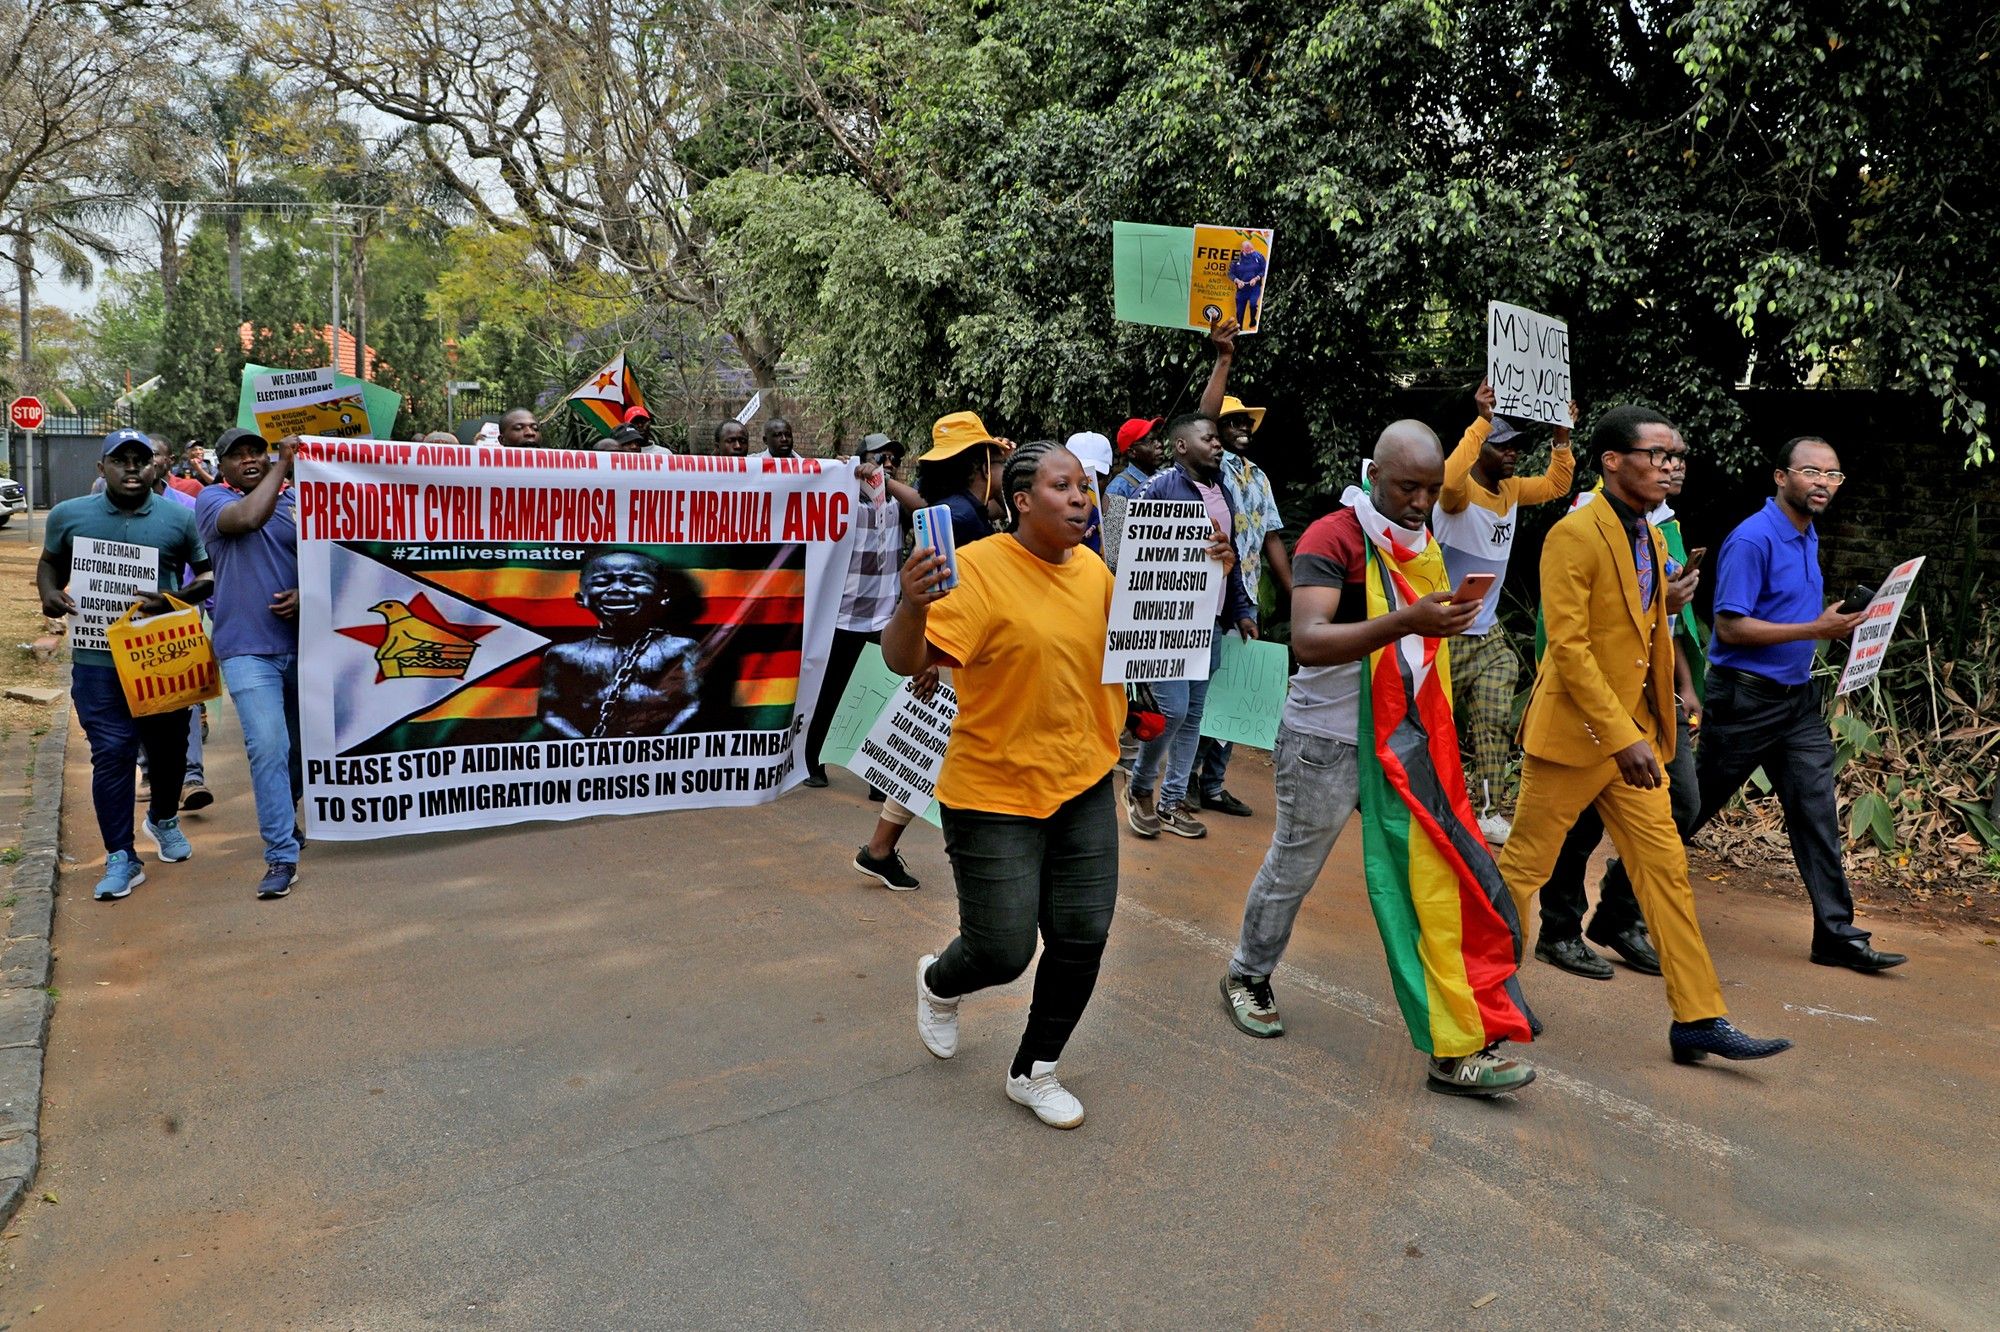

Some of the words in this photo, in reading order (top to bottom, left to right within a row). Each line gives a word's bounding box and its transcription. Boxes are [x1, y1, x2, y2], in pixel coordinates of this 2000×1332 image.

[1197, 247, 1241, 261] FREE
[1204, 262, 1226, 271] JOB
[1493, 308, 1529, 353] MY
[1535, 321, 1570, 364] VOTE
[271, 375, 285, 386] WE
[286, 371, 318, 385] DEMAND
[1492, 360, 1524, 392] MY
[1531, 369, 1570, 403] VOICE
[256, 389, 297, 403] ELECTORAL
[13, 406, 41, 420] STOP
[1500, 394, 1562, 422] #SADC
[337, 424, 362, 438] NOW
[299, 481, 420, 541] PRESIDENT
[424, 484, 485, 542] CYRIL
[489, 487, 617, 543] RAMAPHOSA
[627, 489, 684, 544] FIKILE
[688, 490, 772, 544] MBALULA
[782, 491, 849, 543] ANC
[1128, 524, 1172, 541] POLLS
[1175, 525, 1213, 541] RESH
[92, 541, 106, 555] WE
[106, 543, 141, 560] DEMAND
[391, 546, 586, 562] #Zimlivesmatter
[1135, 546, 1179, 562] WANT
[1182, 547, 1206, 562] WE
[73, 557, 117, 576] ELECTORAL
[89, 578, 103, 592] WE
[104, 581, 138, 597] DEMAND
[1128, 571, 1153, 591] VOTE
[1156, 571, 1208, 592] DIASPORA
[80, 596, 122, 612] DIASPORA
[1133, 600, 1177, 620] DEMAND
[1178, 600, 1194, 620] WE
[84, 615, 104, 625] WE
[75, 626, 108, 638] FRES
[1108, 630, 1157, 652] REFORMS,
[1159, 629, 1211, 650] ELECTORAL
[73, 638, 86, 648] IN
[130, 636, 205, 662] DISCOUNT
[1125, 659, 1168, 680] DEMAND
[1169, 658, 1186, 678] WE
[903, 700, 938, 728] WANT
[890, 711, 914, 737] VOTE
[861, 736, 898, 772] REFORMS,
[886, 732, 922, 763] DEMAND
[308, 756, 393, 786] PLEASE
[398, 750, 457, 782] STOP
[461, 744, 541, 774] AIDING
[546, 736, 700, 768] DICTATORSHIP
[705, 734, 726, 758] IN
[917, 754, 934, 772] WE
[864, 766, 900, 796] DEMAND
[314, 796, 346, 822] TO
[352, 794, 413, 823] STOP
[418, 780, 571, 818] IMMIGRATION
[577, 774, 649, 802] CRISIS
[655, 772, 676, 796] IN
[682, 768, 749, 794] SOUTH
[895, 788, 912, 805] WE
